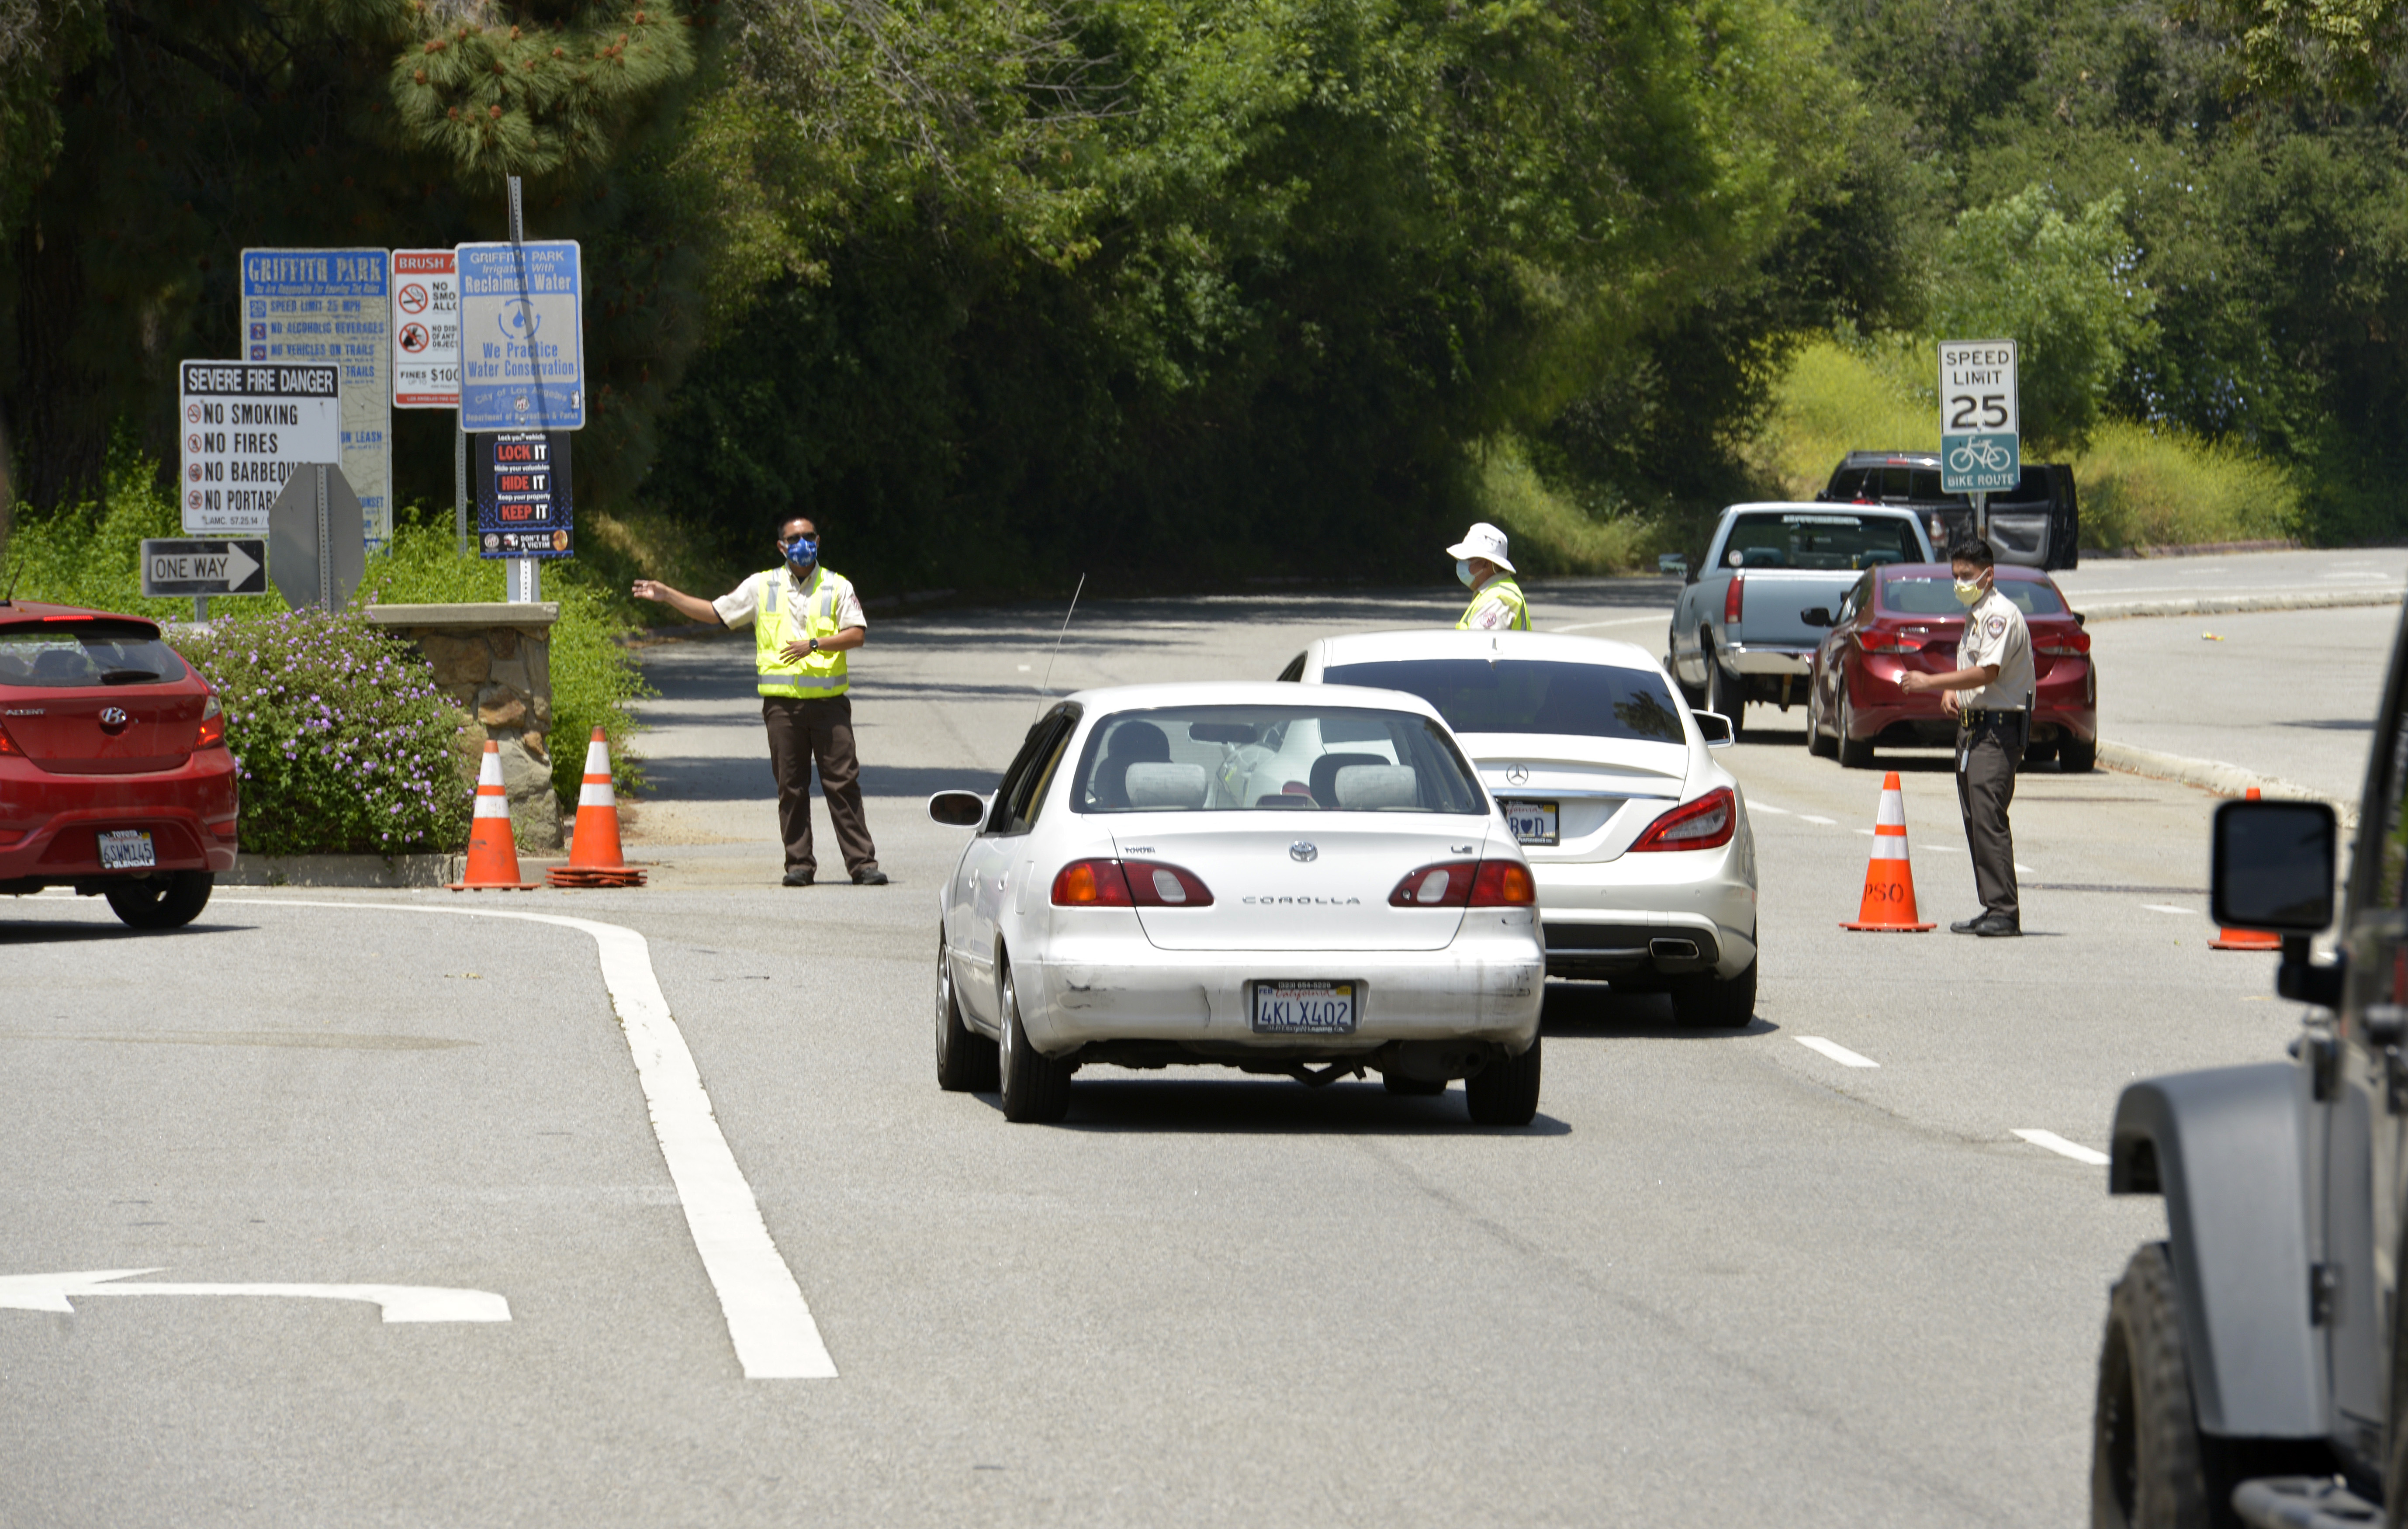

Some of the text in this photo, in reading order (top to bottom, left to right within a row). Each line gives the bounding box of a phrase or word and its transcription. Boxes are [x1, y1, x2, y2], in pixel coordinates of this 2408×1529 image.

[399, 257, 444, 269] BRUSH
[470, 251, 564, 263] GRIFFITH PARK
[249, 257, 382, 282] GRIFFITH PARK
[532, 263, 554, 273] With
[432, 282, 448, 291] NO
[465, 273, 571, 293] Reclaimed Water
[271, 300, 360, 312] SPEED LIMIT 25 MPH
[271, 322, 384, 334] NO ALCOHOLIC BEVERAGES
[271, 344, 375, 356] NO VEHICLES ON TRAILS
[483, 342, 558, 359] We Practice
[1947, 350, 2009, 366] SPEED
[346, 366, 375, 377] TRAILS
[468, 360, 574, 378] Water Conservation
[188, 368, 333, 393] SEVERE FIRE DANGER
[1954, 370, 2002, 385] LIMIT
[475, 393, 493, 405] City
[497, 388, 506, 397] of
[532, 386, 567, 402] Angeles
[204, 403, 298, 425] NO SMOKING
[466, 413, 502, 422] Department
[505, 413, 512, 421] of
[560, 412, 578, 420] Parks
[1951, 394, 2008, 429] 25
[204, 433, 278, 453] NO FIRES
[356, 431, 382, 443] LEASH
[498, 444, 547, 461] LOCK IT
[205, 461, 224, 482] NO
[502, 474, 545, 491] HIDE IT
[1948, 474, 2014, 487] BIKE ROUTE
[205, 489, 221, 510] NO
[502, 504, 547, 520] KEEP IT
[156, 557, 228, 579] ONE WAY
[104, 843, 152, 864] 6SWM145
[1450, 844, 1473, 854] LE
[113, 858, 155, 868] GLENDALE
[1242, 896, 1360, 904] COROLLA
[1864, 882, 1904, 903] PSO
[1276, 989, 1336, 1001] California
[1262, 1000, 1348, 1026] 4KLX402
